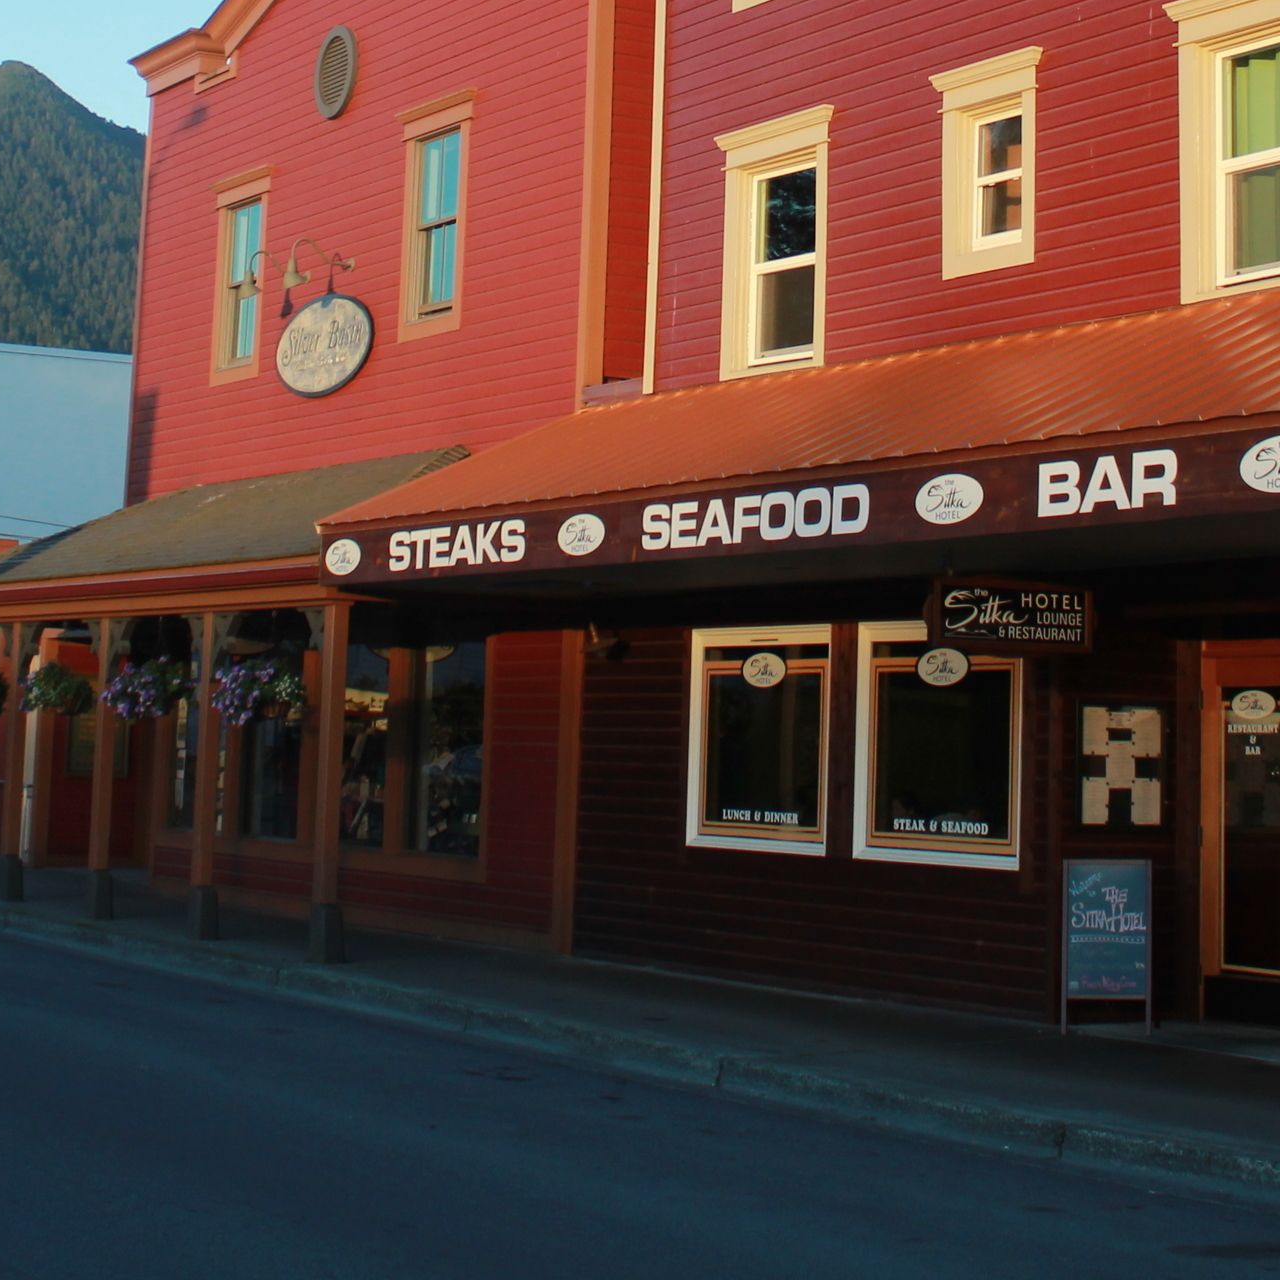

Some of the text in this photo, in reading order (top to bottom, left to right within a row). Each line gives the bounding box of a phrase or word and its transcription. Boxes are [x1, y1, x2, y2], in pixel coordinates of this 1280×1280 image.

[1036, 449, 1178, 518] BAR
[926, 484, 971, 512] Sitka
[641, 484, 870, 551] SEAFOOD
[935, 510, 960, 520] HOTEL
[565, 522, 597, 545] Sitka
[388, 519, 526, 572] STEAKS
[974, 588, 988, 597] the
[944, 589, 1082, 629] Sitka HOTEL
[1037, 611, 1082, 626] LOUNGE
[998, 626, 1082, 642] & RESTAURANT
[1227, 724, 1279, 733] RESTAURANT
[1245, 746, 1261, 755] BAR
[722, 808, 798, 824] LUNCH & DINNER
[893, 818, 988, 835] STEAK & SEAFOOD
